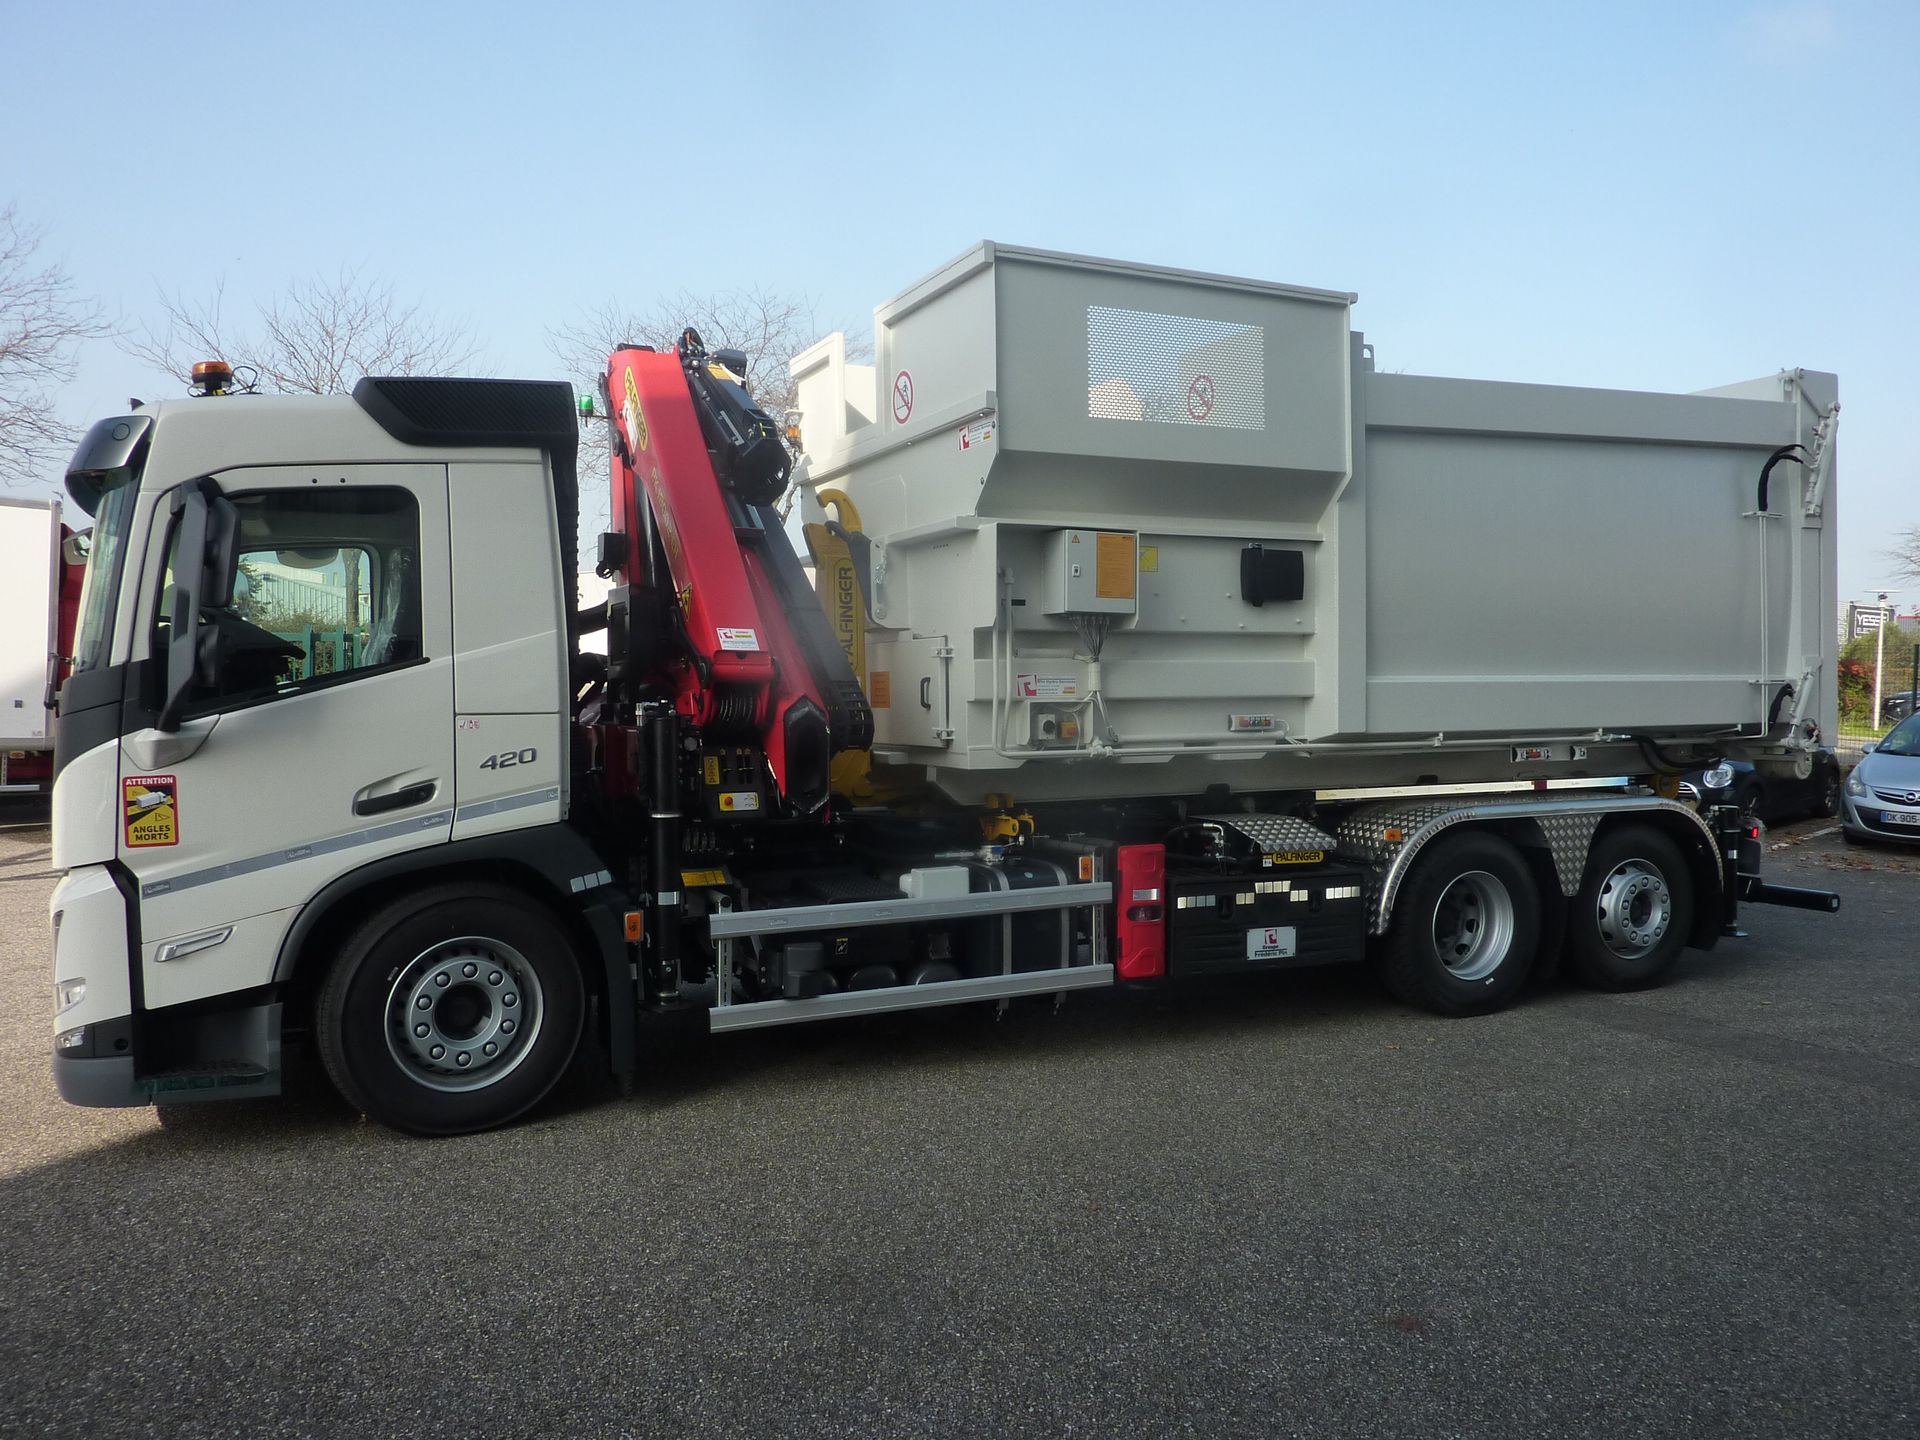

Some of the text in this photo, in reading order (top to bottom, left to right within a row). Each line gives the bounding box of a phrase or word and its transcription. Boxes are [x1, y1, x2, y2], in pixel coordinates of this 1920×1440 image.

[839, 566, 855, 667] ALFINGER
[480, 747, 537, 770] 420
[126, 777, 173, 785] ATTENTION
[133, 824, 171, 833] ANGLES
[135, 833, 169, 841] MORTS
[1276, 851, 1320, 862] PALFINGER
